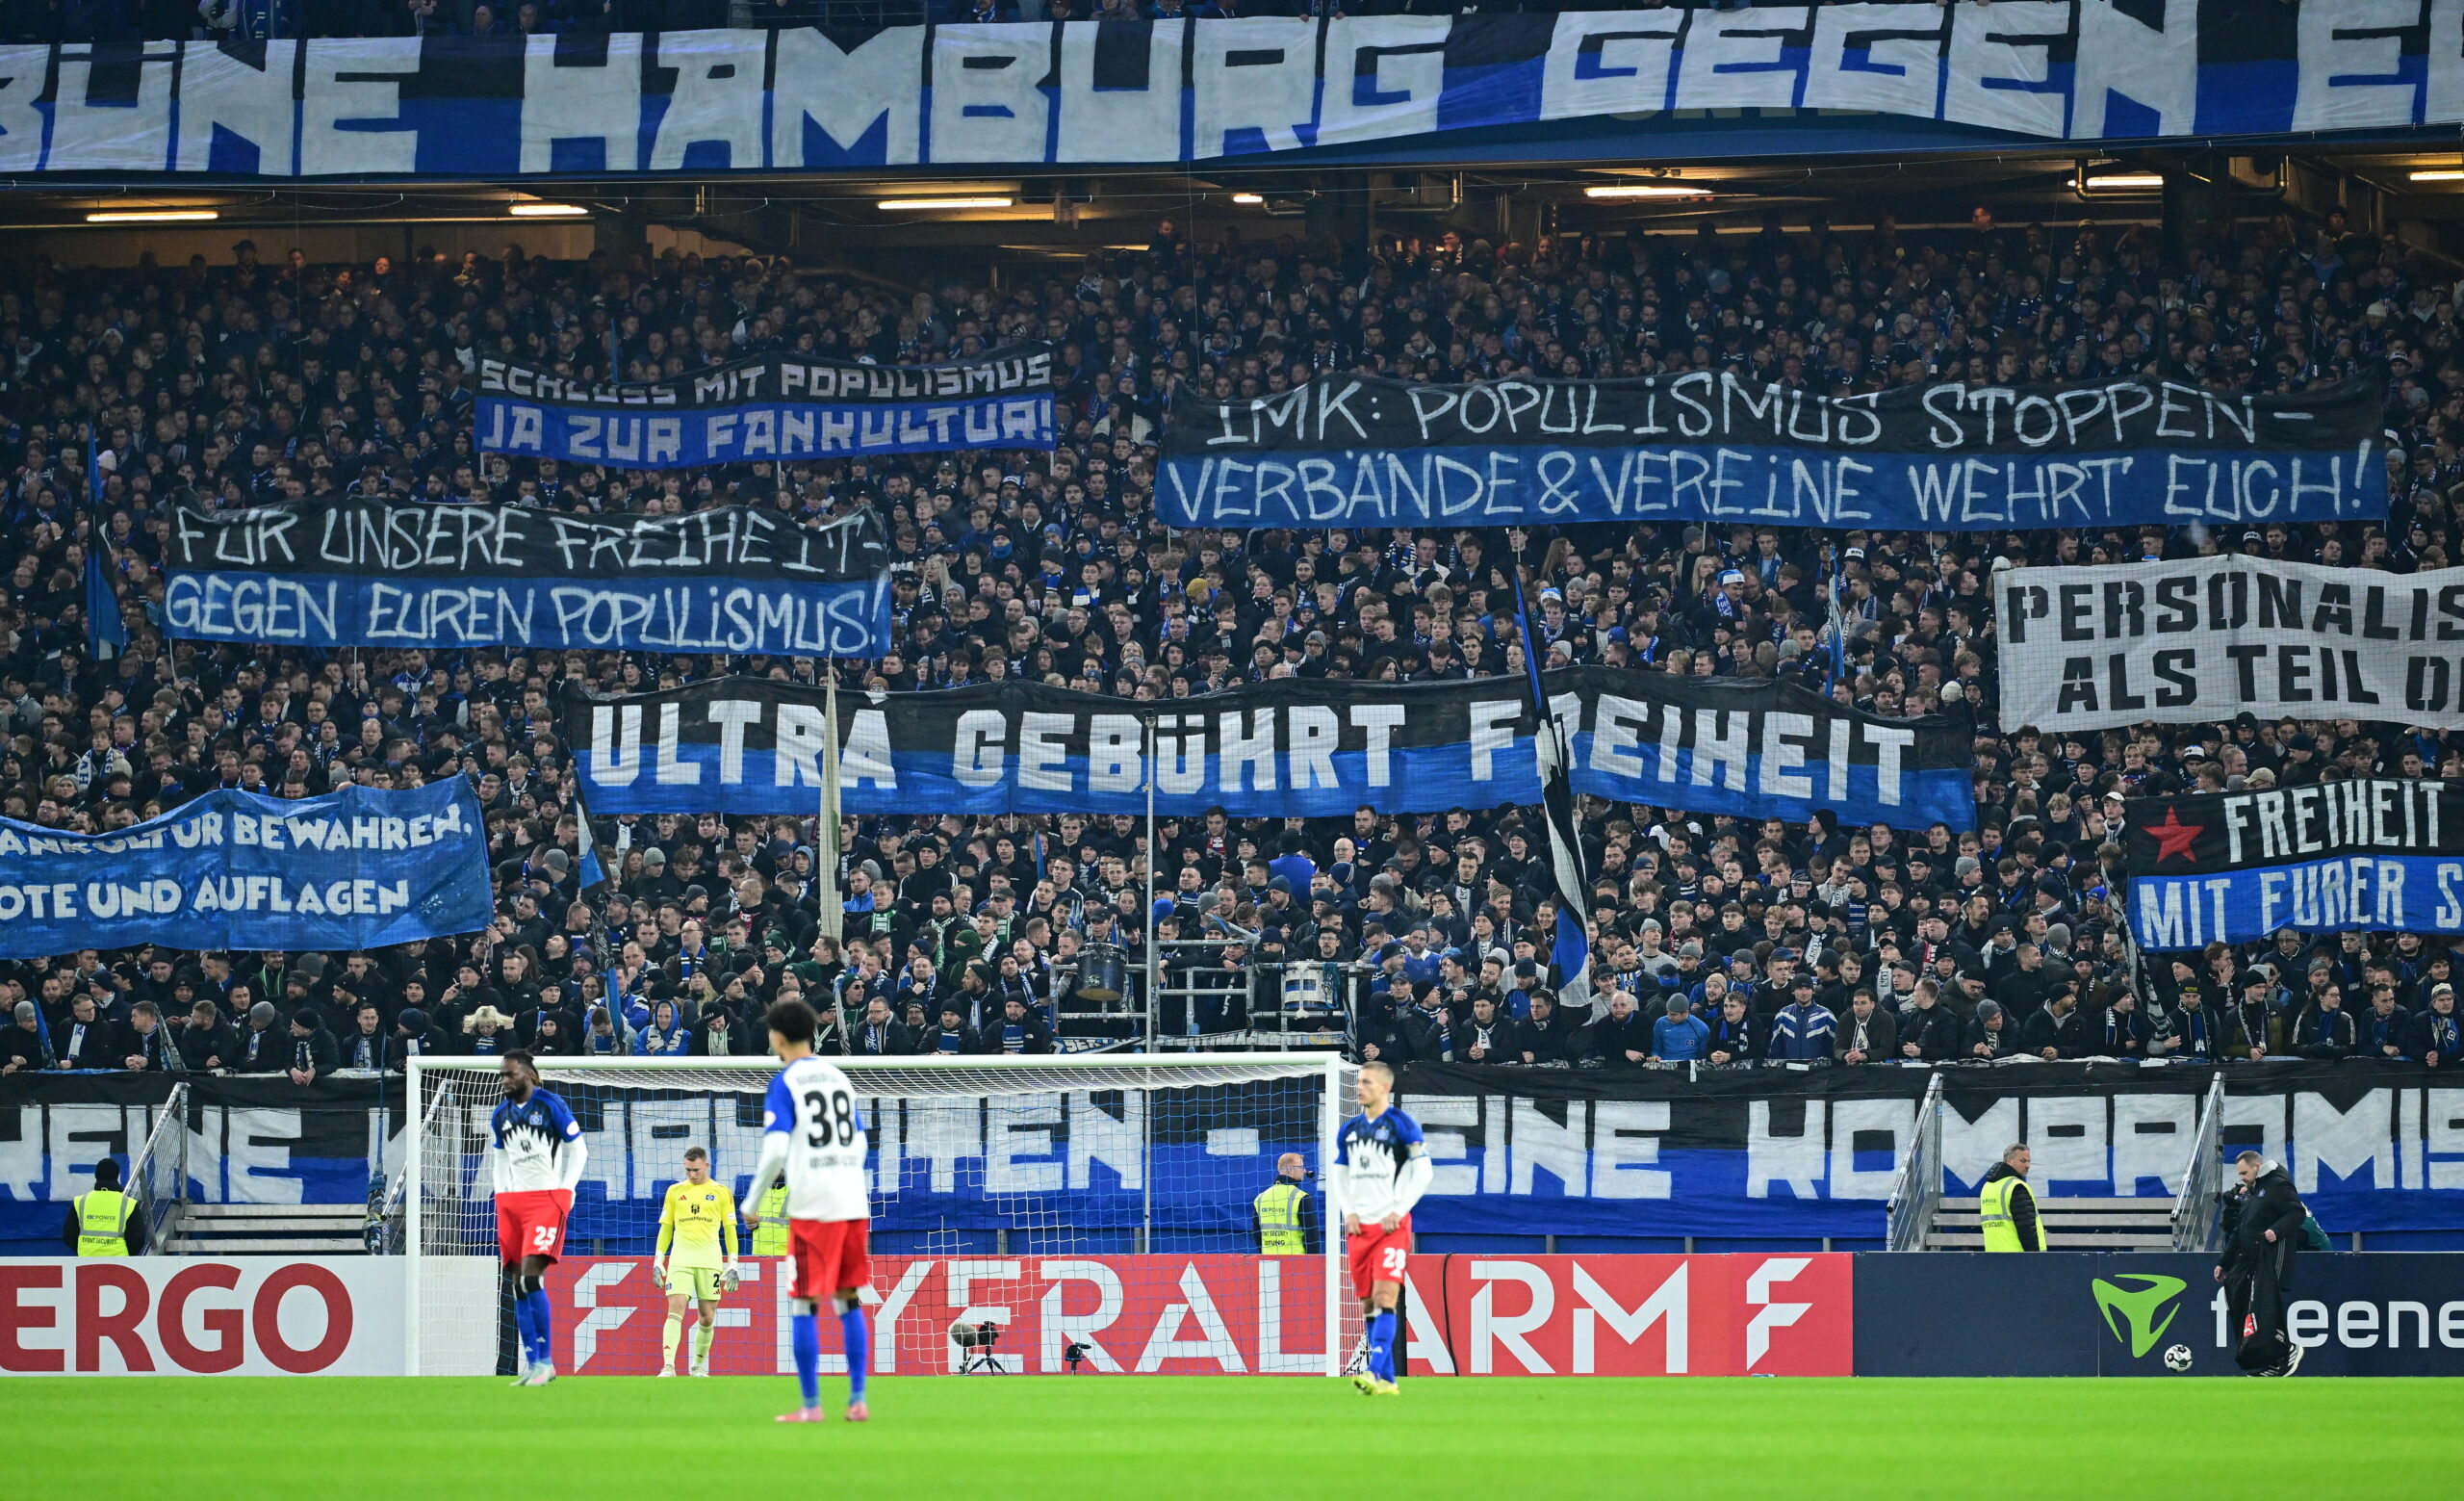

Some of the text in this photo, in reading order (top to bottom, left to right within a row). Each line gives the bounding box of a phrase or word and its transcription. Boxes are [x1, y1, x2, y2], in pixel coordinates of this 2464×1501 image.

[520, 13, 1452, 174] HAMBURG
[1541, 0, 2199, 140] GEGEN
[2295, 0, 2464, 133] E
[694, 366, 766, 404] MIT
[781, 352, 1051, 399] POPULISMUS
[481, 399, 1052, 463] JA ZUR FANKULTUR!
[1206, 381, 1382, 445] IMK:
[1908, 454, 2134, 523] WEHRT
[2164, 438, 2373, 522] EUCH!
[176, 505, 298, 566] FÜR
[321, 505, 532, 571] UNSERE
[165, 574, 338, 641] GEGEN
[365, 585, 534, 645] EUREN
[2007, 571, 2464, 644] PERSONALIS
[2057, 644, 2464, 714] ALS TEIL D
[952, 705, 1406, 795] GEBÜHRT
[233, 803, 473, 851] BEWAHREN,
[2223, 779, 2445, 864] FREIHEIT
[0, 875, 410, 920] OTE UND AUFLAGEN
[2139, 878, 2231, 948] MIT
[804, 1090, 854, 1148] 38
[1318, 1092, 1672, 1201] EINE
[533, 1226, 558, 1247] 25
[1382, 1246, 1407, 1269] 28
[0, 1263, 354, 1374] ERGO
[2211, 1285, 2464, 1349] feene
